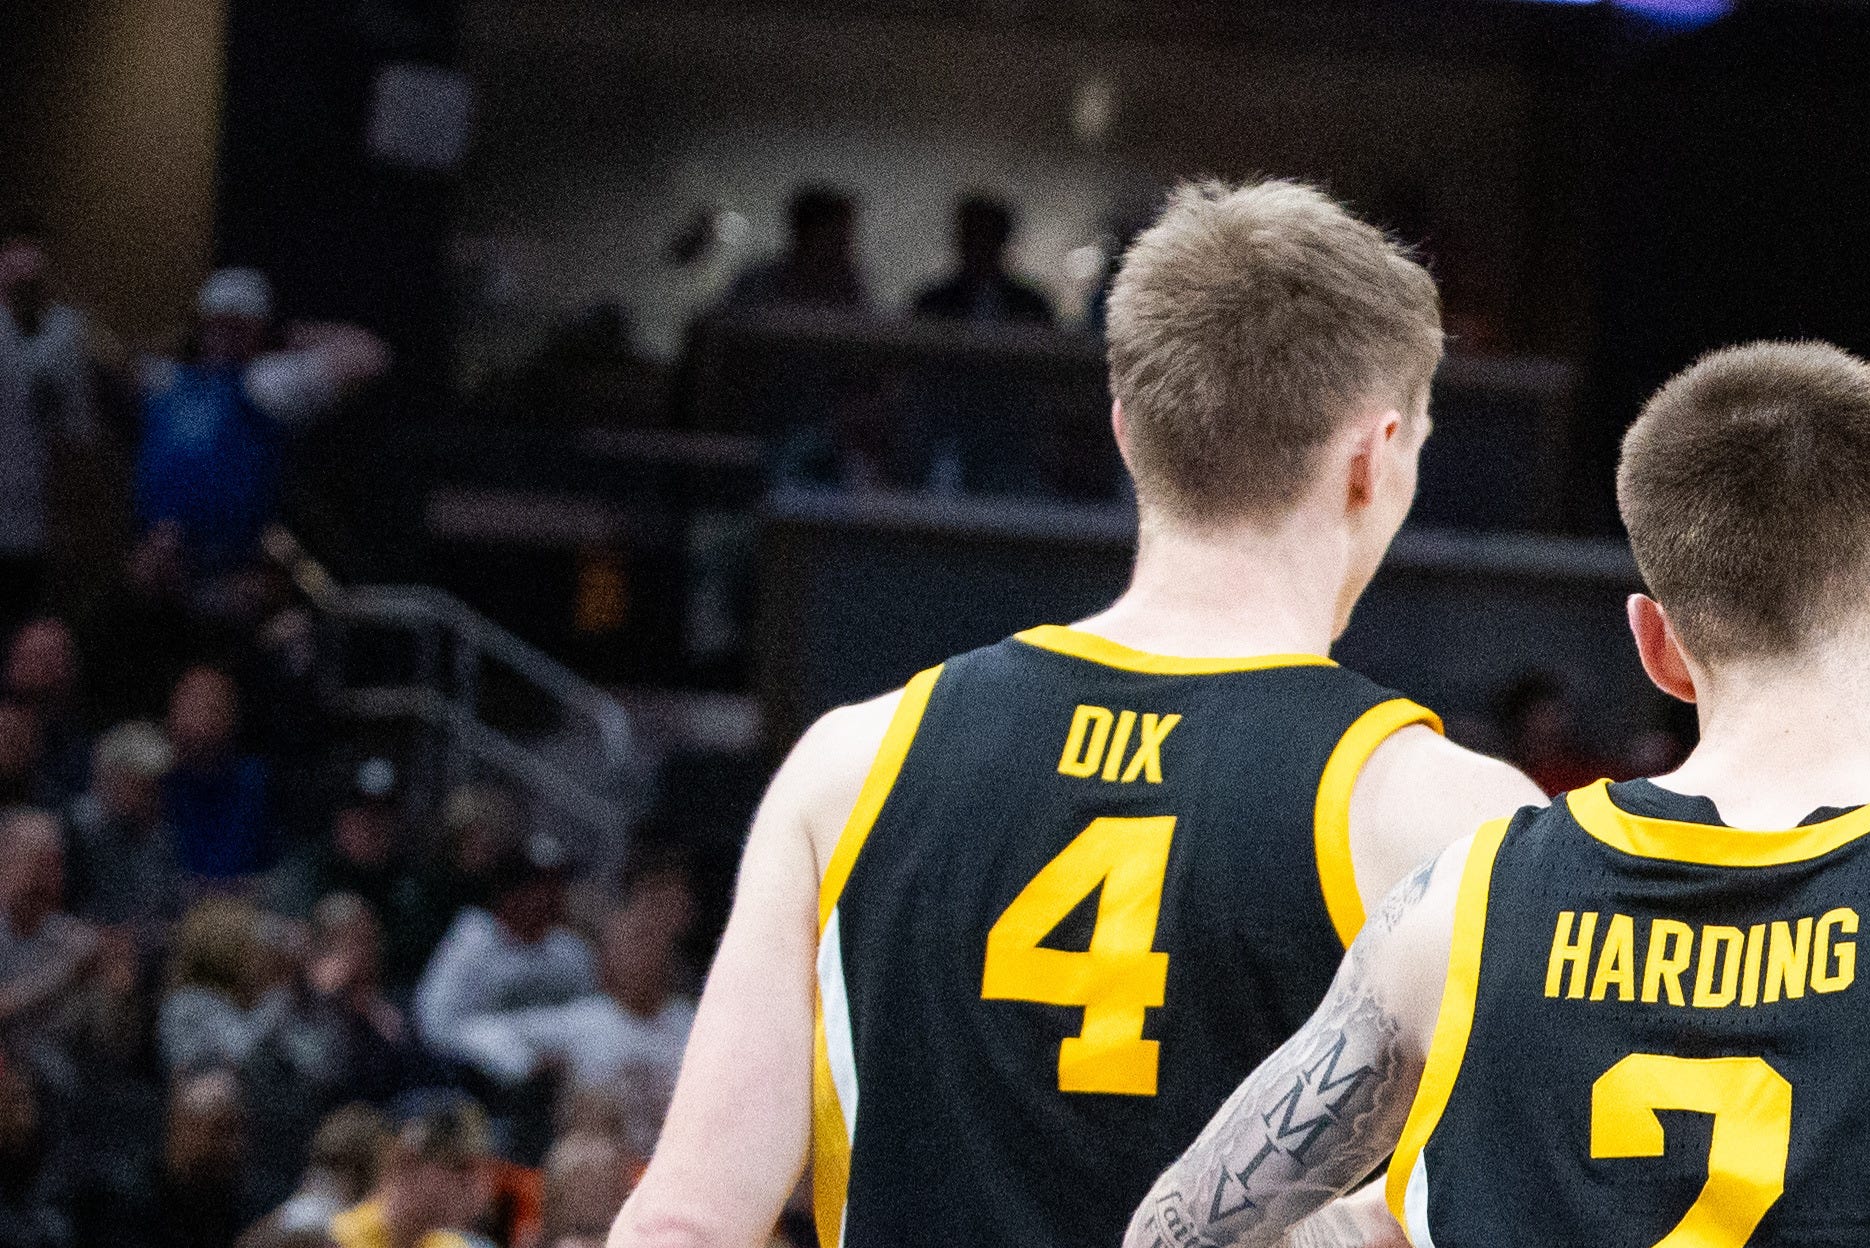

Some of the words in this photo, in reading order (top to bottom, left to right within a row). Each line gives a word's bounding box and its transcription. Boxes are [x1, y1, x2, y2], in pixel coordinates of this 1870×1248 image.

[1058, 703, 1181, 785] DIX
[979, 815, 1178, 1097] 4
[1543, 907, 1860, 1008] HARDING
